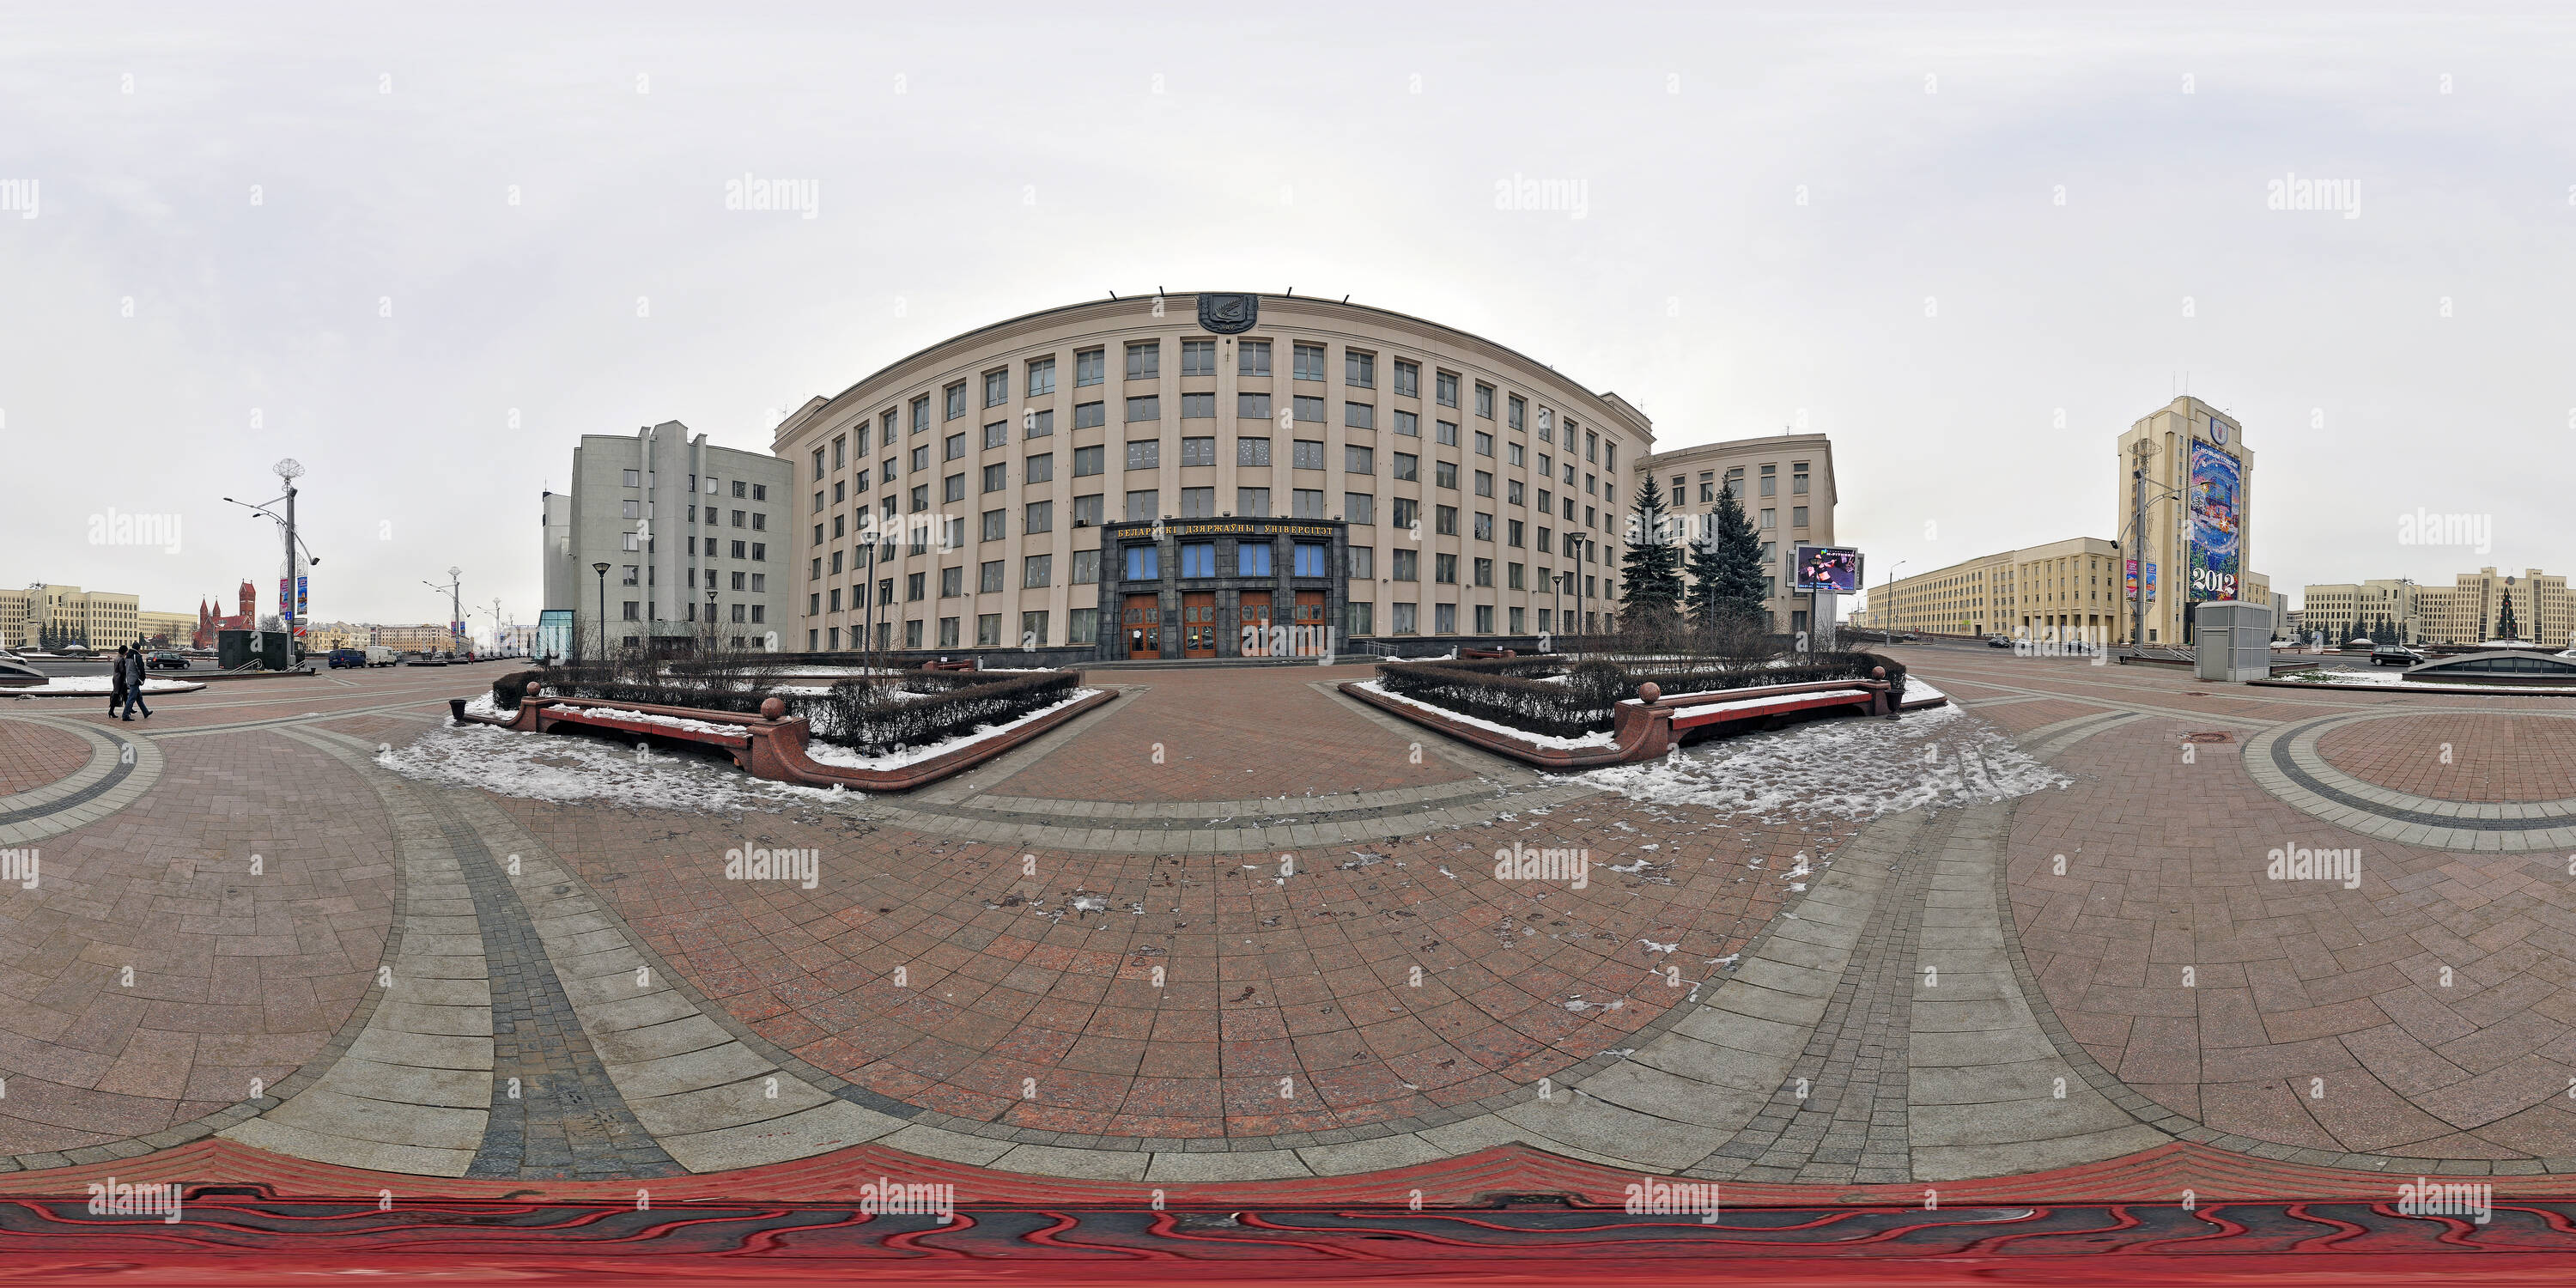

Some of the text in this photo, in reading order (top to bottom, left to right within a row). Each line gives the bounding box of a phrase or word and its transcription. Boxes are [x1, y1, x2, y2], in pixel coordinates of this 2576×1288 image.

[1118, 523, 1333, 538] БЕЛАРУСКІ ДЗЯРЖАЎНЫ УНІВЕРСІТЭТ
[2192, 568, 2235, 595] 2012
